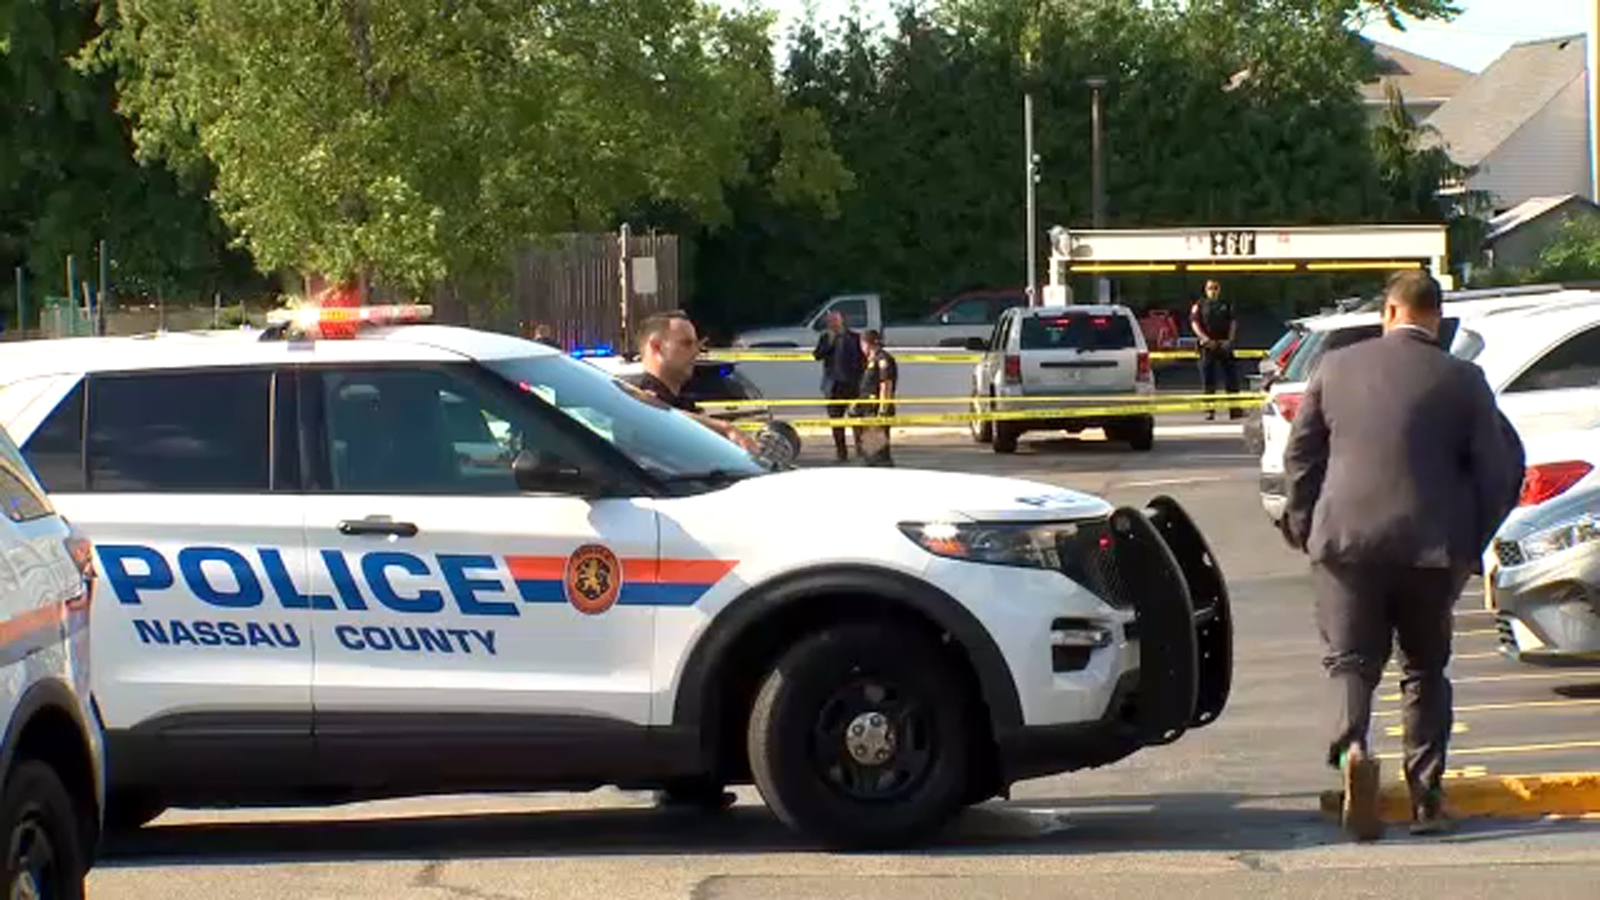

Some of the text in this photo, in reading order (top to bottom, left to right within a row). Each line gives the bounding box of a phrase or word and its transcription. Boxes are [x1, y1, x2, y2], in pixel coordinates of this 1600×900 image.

[95, 545, 520, 616] POLICE
[133, 619, 497, 655] NASSAU COUNTY
